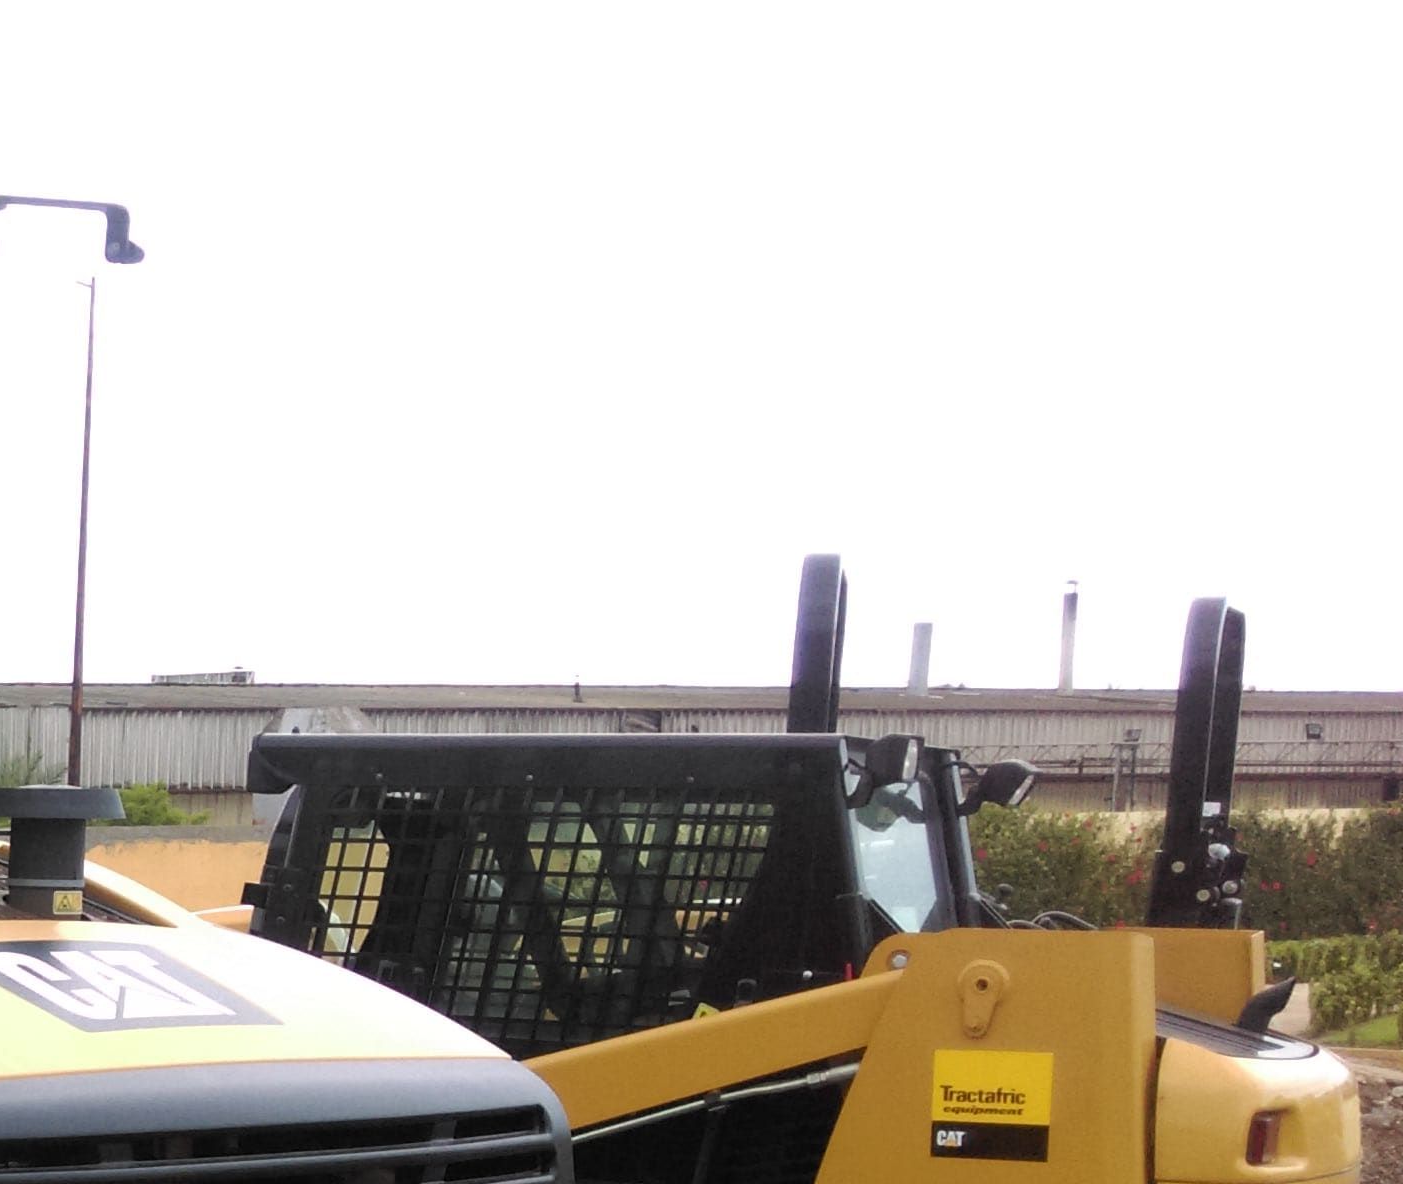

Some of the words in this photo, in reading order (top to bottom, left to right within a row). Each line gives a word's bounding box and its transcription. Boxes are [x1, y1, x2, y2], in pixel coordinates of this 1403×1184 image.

[940, 1085, 1026, 1105] Tractafric
[943, 1105, 1024, 1116] equipment
[937, 1130, 966, 1147] CAT
